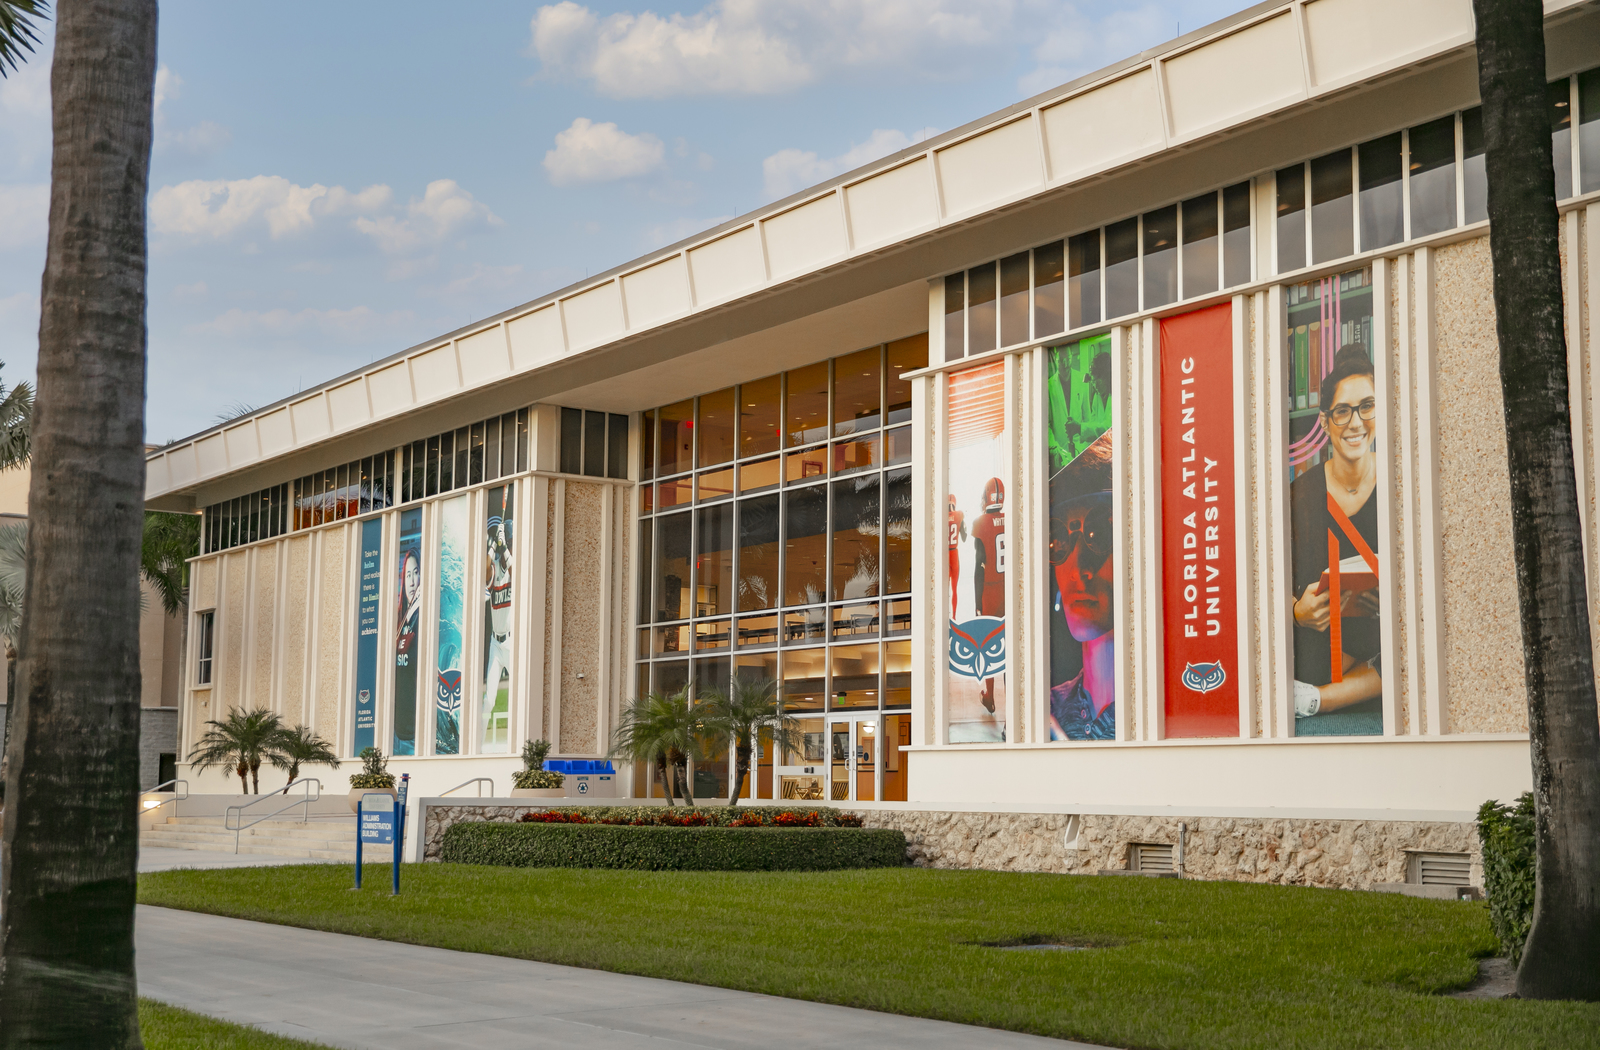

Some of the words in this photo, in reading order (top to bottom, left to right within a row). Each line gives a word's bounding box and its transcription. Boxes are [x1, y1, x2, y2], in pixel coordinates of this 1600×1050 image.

[1181, 357, 1196, 499] ATLANTIC
[1204, 456, 1220, 636] UNIVERSITY
[364, 560, 375, 569] helm
[1183, 511, 1198, 638] FLORIDA
[362, 814, 380, 822] WILLIAMS
[362, 822, 392, 830] ADMINISTRATION
[362, 830, 379, 838] BUILDING
